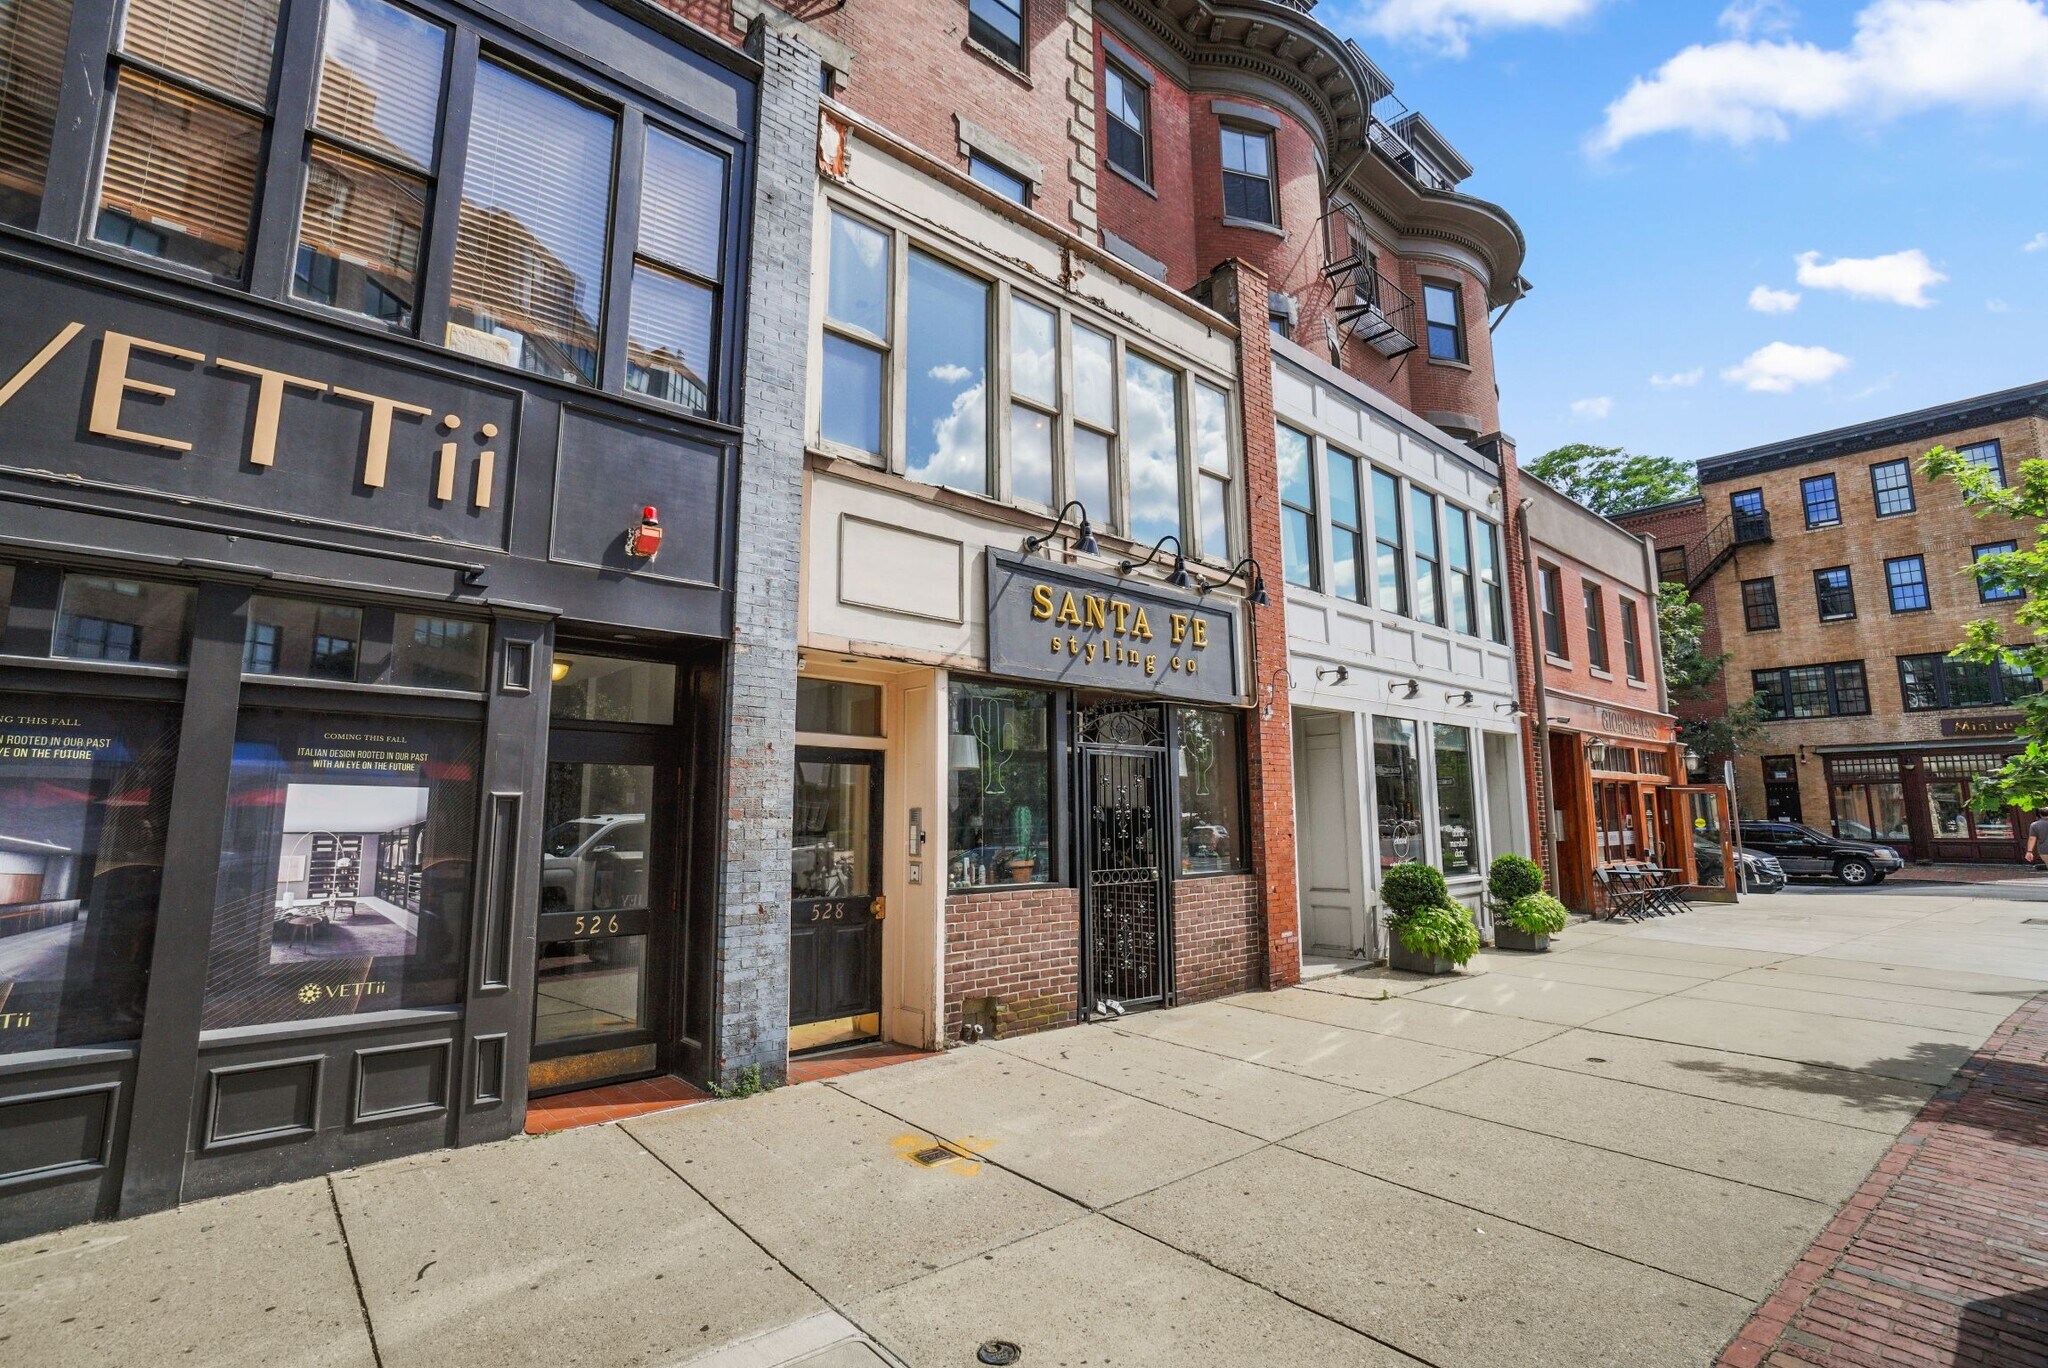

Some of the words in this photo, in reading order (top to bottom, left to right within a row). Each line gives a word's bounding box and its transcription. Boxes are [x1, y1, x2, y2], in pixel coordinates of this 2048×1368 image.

[1033, 584, 1153, 639] SANTA
[1170, 613, 1208, 648] FE
[1052, 635, 1157, 675] styling
[18, 716, 48, 725] THIS
[51, 718, 82, 727] FALL
[6, 735, 47, 746] ROOTED
[50, 737, 60, 746] IN
[63, 737, 84, 747] OUR
[86, 738, 112, 748] PAST
[323, 732, 362, 741] COMING
[364, 734, 384, 742] THIS
[386, 735, 408, 743] FALL
[13, 747, 28, 758] ON
[31, 748, 51, 759] THE
[53, 749, 93, 760] FUTURE
[298, 747, 328, 758] ITALIAN
[329, 749, 356, 759] DESIGN
[357, 751, 385, 760] ROOTED
[386, 752, 394, 760] IN
[395, 752, 409, 761] OUR
[410, 753, 429, 762] PAST
[312, 759, 332, 768] WITH
[334, 760, 344, 768] AN
[346, 761, 360, 769] EYE
[362, 762, 372, 770] ON
[374, 762, 387, 771] THE
[388, 763, 415, 772] FUTURE
[811, 902, 845, 921] 528
[574, 914, 619, 935] 526
[326, 981, 386, 998] VETTii
